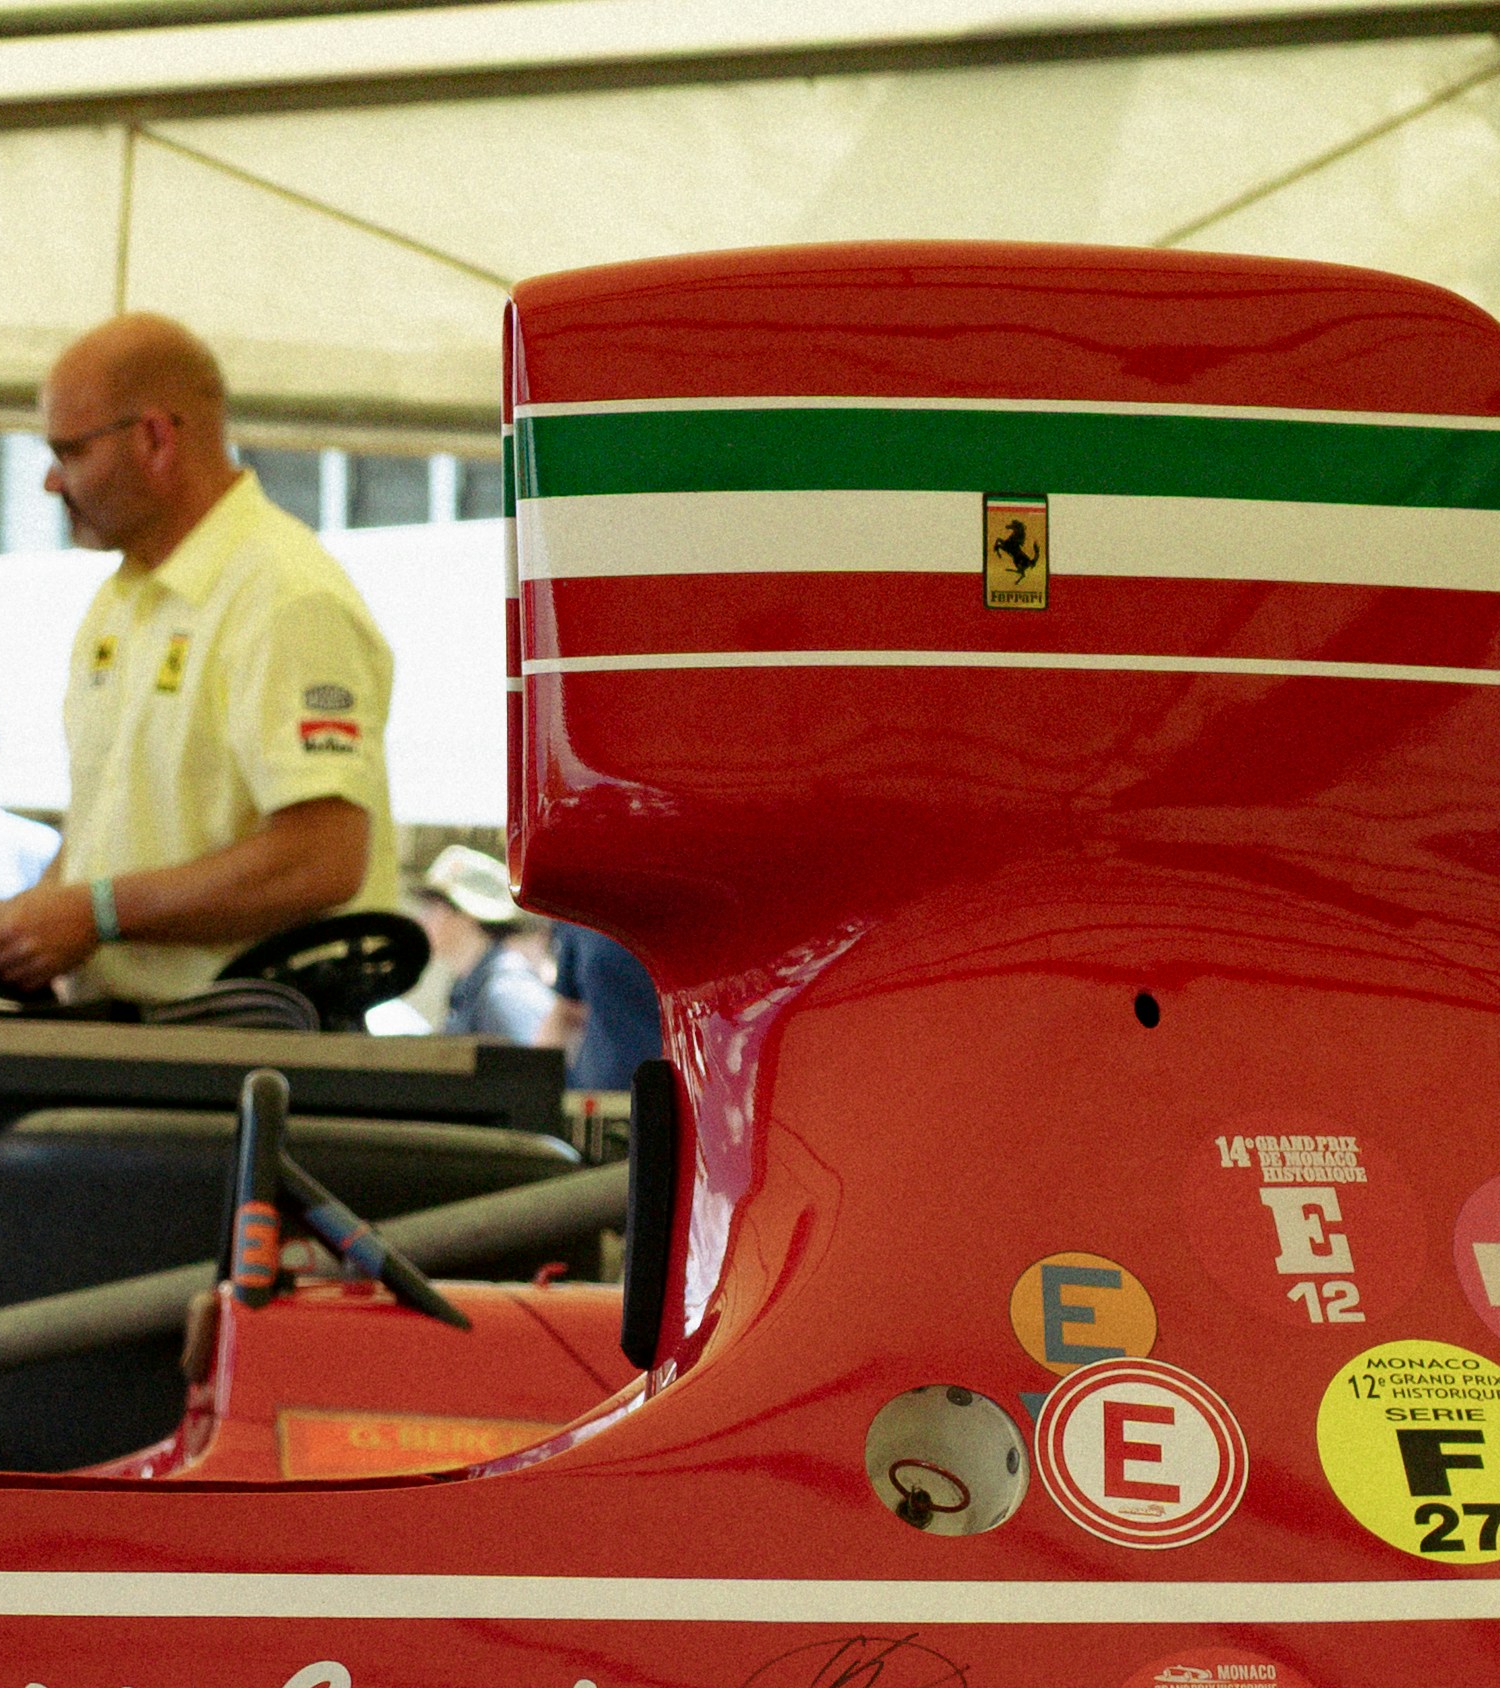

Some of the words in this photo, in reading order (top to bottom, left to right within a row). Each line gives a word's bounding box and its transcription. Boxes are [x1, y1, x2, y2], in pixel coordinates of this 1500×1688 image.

[990, 589, 1043, 603] Ferrari
[1255, 1135, 1315, 1152] GRAND
[1315, 1135, 1360, 1153] PRIX
[1259, 1151, 1282, 1167] DE
[1285, 1151, 1358, 1167] MONACO
[1263, 1167, 1368, 1184] HISTORIQUE
[1259, 1186, 1355, 1274] E
[1286, 1280, 1366, 1323] 12
[1041, 1264, 1126, 1365] E
[1366, 1358, 1480, 1370] MONACO
[1389, 1373, 1456, 1385] GRAND
[1385, 1407, 1487, 1422] SERIE
[1103, 1400, 1180, 1504] E
[1396, 1429, 1486, 1497] F
[1216, 1664, 1277, 1681] MONACO
